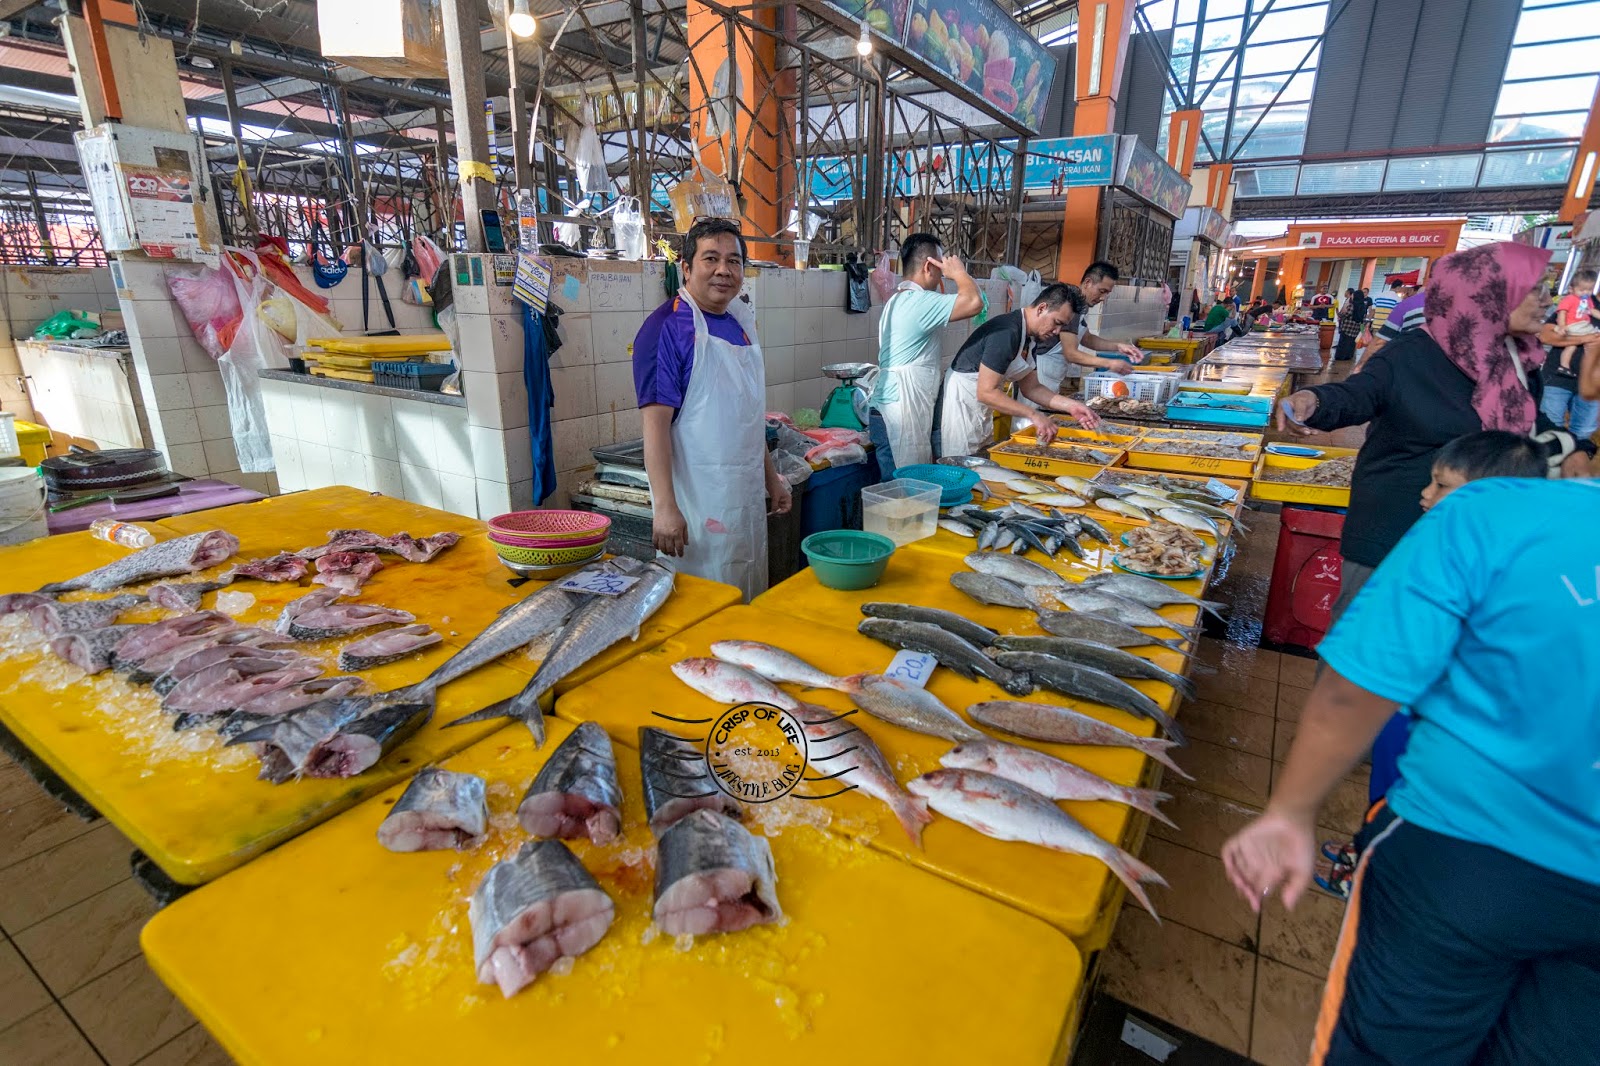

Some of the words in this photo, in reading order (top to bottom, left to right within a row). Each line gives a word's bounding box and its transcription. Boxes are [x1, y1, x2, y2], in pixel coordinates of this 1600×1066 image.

[1048, 148, 1102, 164] HASSAN
[1082, 164, 1101, 173] IKAN
[1355, 235, 1398, 244] KAFETERIA
[1400, 235, 1406, 243] &
[1408, 235, 1431, 243] BLOK
[1433, 235, 1440, 243] C
[1024, 457, 1050, 469] 4647
